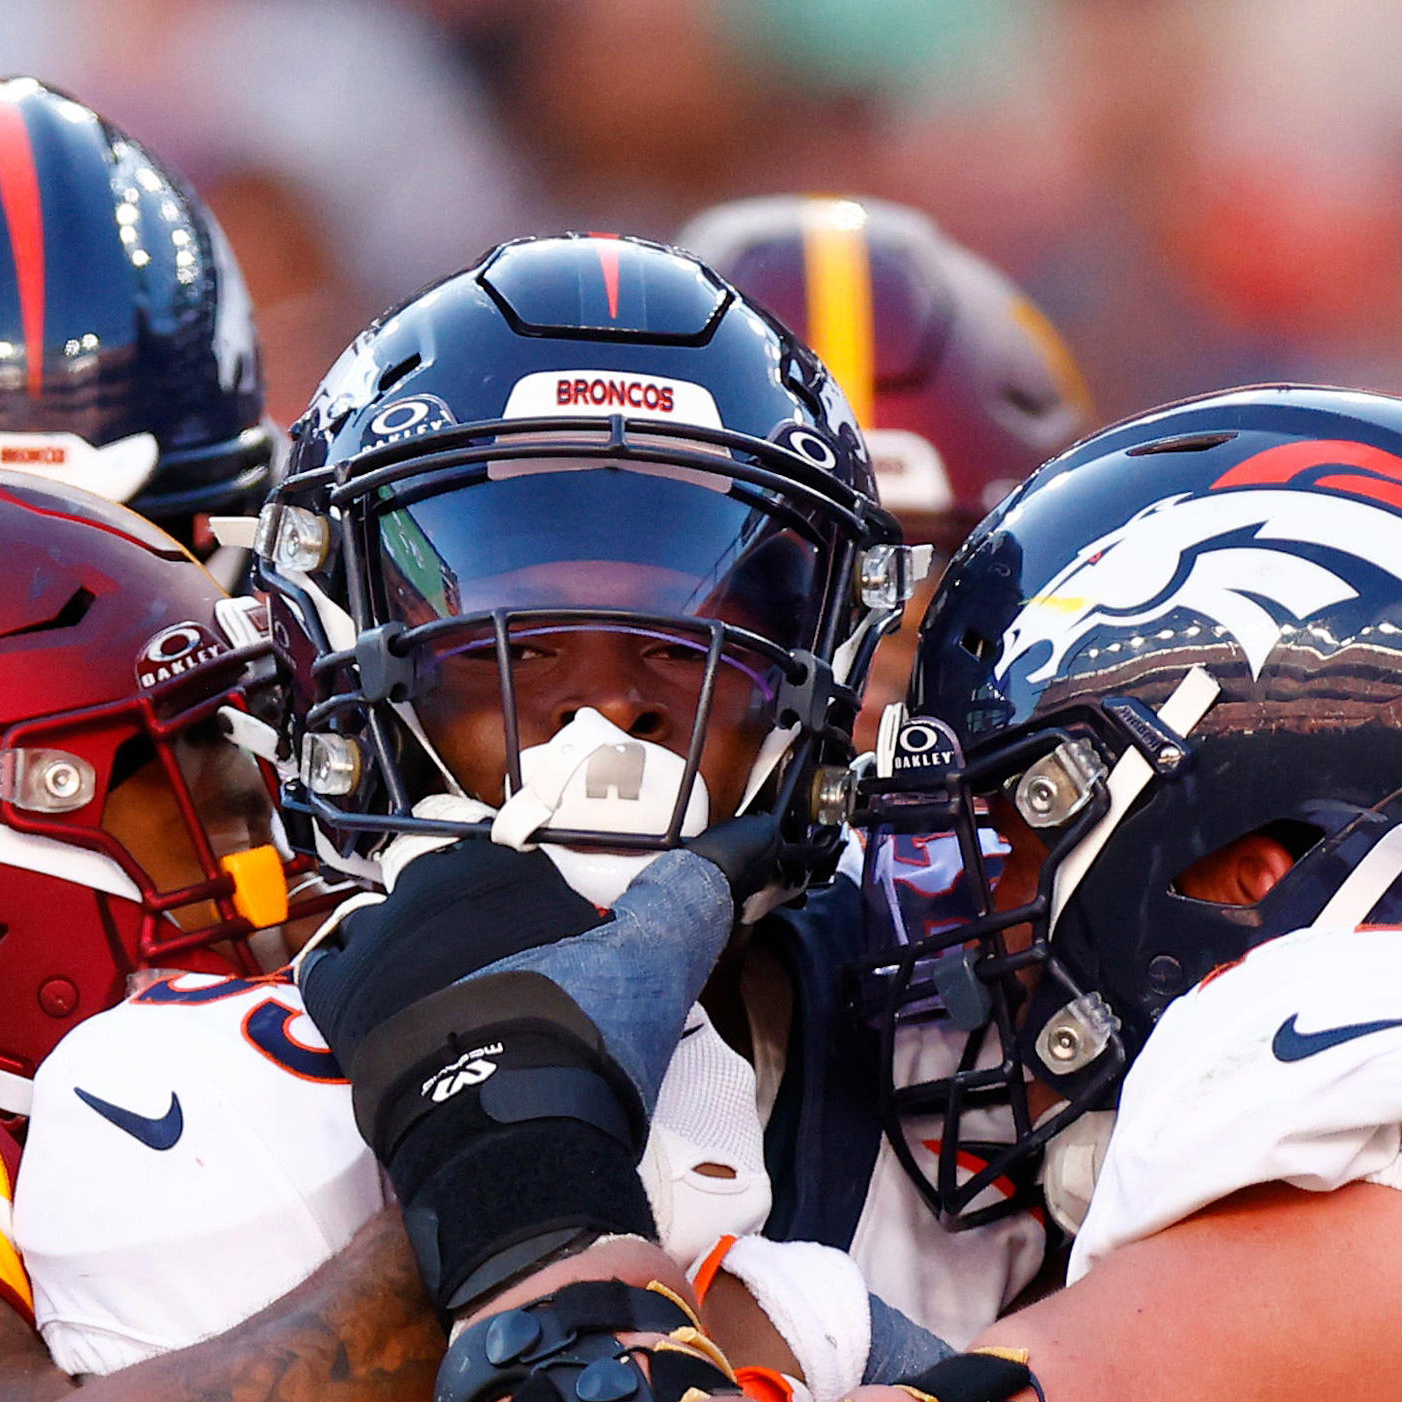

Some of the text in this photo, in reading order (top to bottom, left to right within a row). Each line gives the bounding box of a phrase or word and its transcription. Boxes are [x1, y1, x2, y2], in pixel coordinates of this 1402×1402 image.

[557, 379, 674, 412] BRONCOS
[141, 644, 220, 688] OAKLEY
[894, 751, 952, 769] OAKLEY
